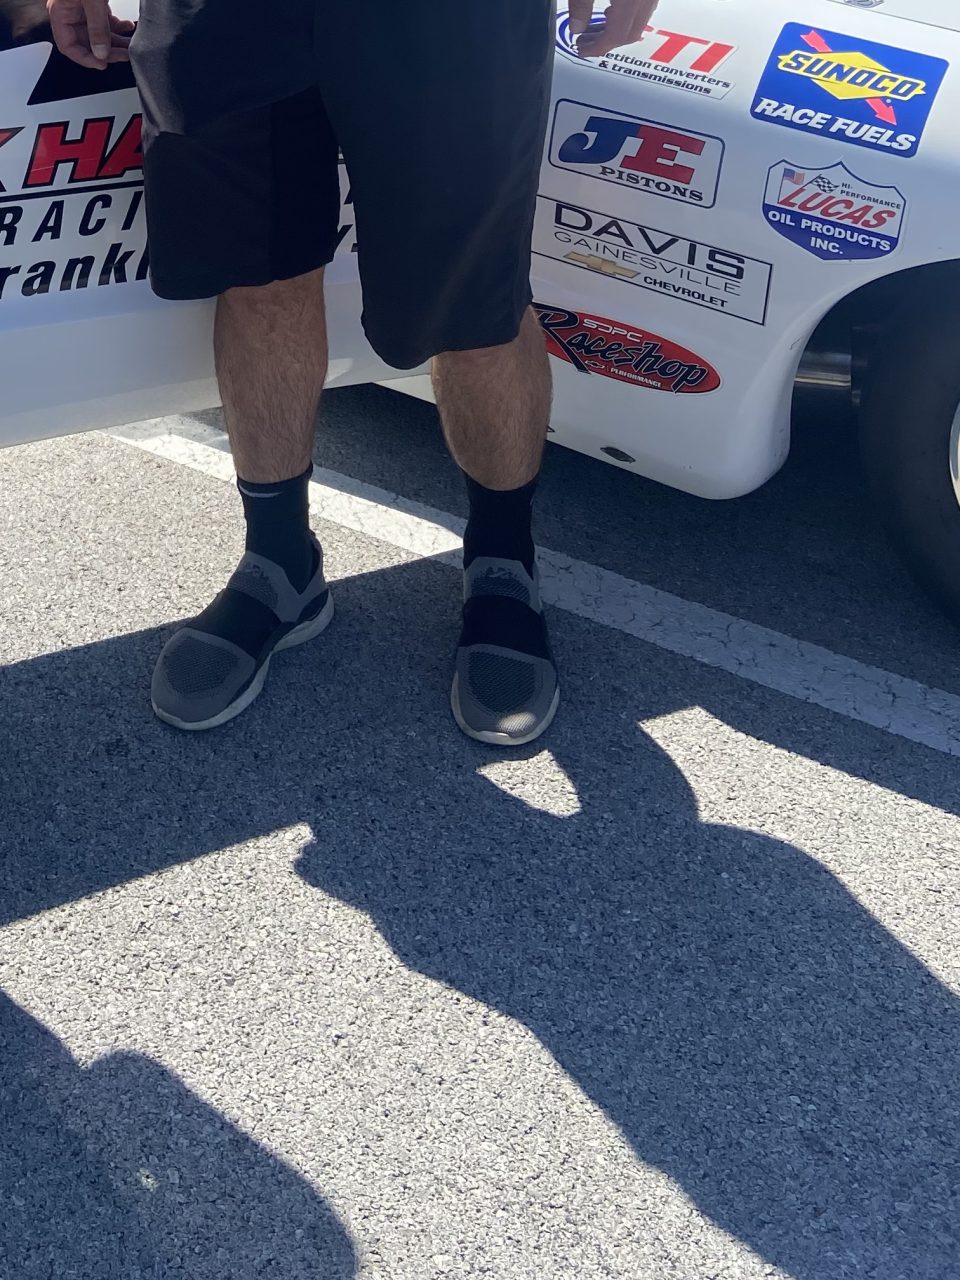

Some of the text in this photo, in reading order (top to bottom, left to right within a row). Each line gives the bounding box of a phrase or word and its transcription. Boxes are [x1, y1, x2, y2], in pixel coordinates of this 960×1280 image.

[641, 24, 734, 74] TI
[598, 60, 712, 95] & transmissions
[653, 63, 731, 89] converters
[782, 52, 921, 97] SUNOCO
[754, 97, 917, 151] RACE FUELS
[558, 116, 706, 185] JE
[599, 165, 703, 202] PISTONS
[840, 190, 901, 210] PERFORMANCE
[778, 188, 896, 229] LUCAS
[554, 202, 744, 280] DAVIS
[768, 210, 890, 251] OIL PRODUCTS
[810, 236, 843, 255] INC.
[554, 231, 740, 296] GAINESVILLE
[643, 276, 728, 308] CHEVROLET
[532, 303, 710, 394] Raceshop
